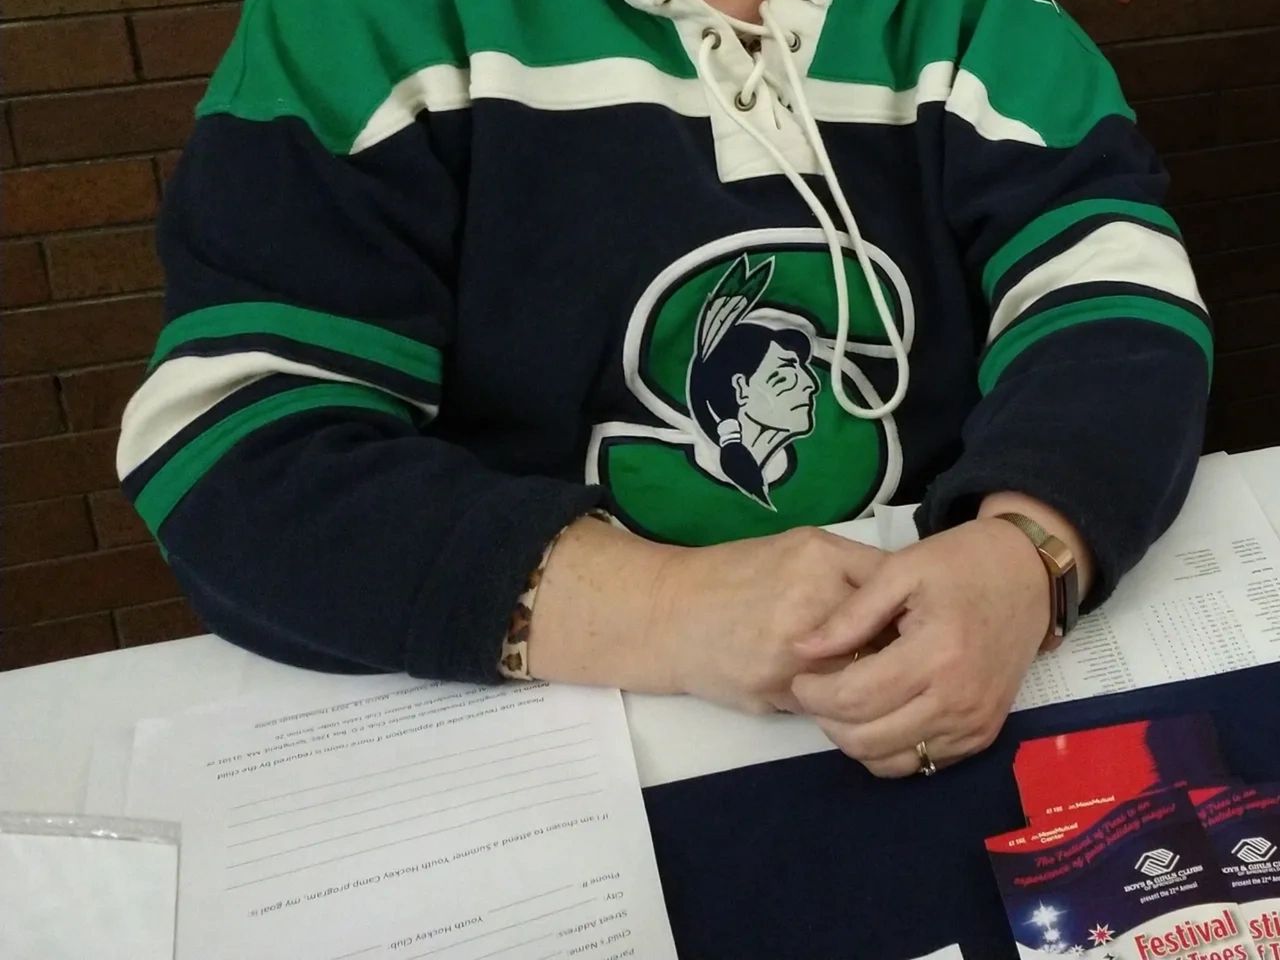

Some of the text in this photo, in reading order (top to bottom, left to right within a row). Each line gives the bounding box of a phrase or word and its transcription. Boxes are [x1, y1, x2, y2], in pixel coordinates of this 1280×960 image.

[385, 723, 434, 740] application
[259, 760, 271, 769] by
[273, 751, 313, 767] required
[242, 766, 257, 774] the
[546, 820, 578, 833] chosen
[580, 815, 595, 824] am
[502, 832, 531, 847] attend
[534, 828, 544, 837] to
[452, 843, 491, 860] Summer
[421, 857, 449, 871] Youth
[383, 864, 418, 881] Hockey
[590, 872, 620, 885] Phone
[353, 875, 381, 889] Camp
[261, 902, 282, 915] goal
[285, 898, 301, 907] my
[454, 915, 483, 929] Youth
[416, 924, 451, 942] Hockey
[1134, 909, 1238, 960] Festival
